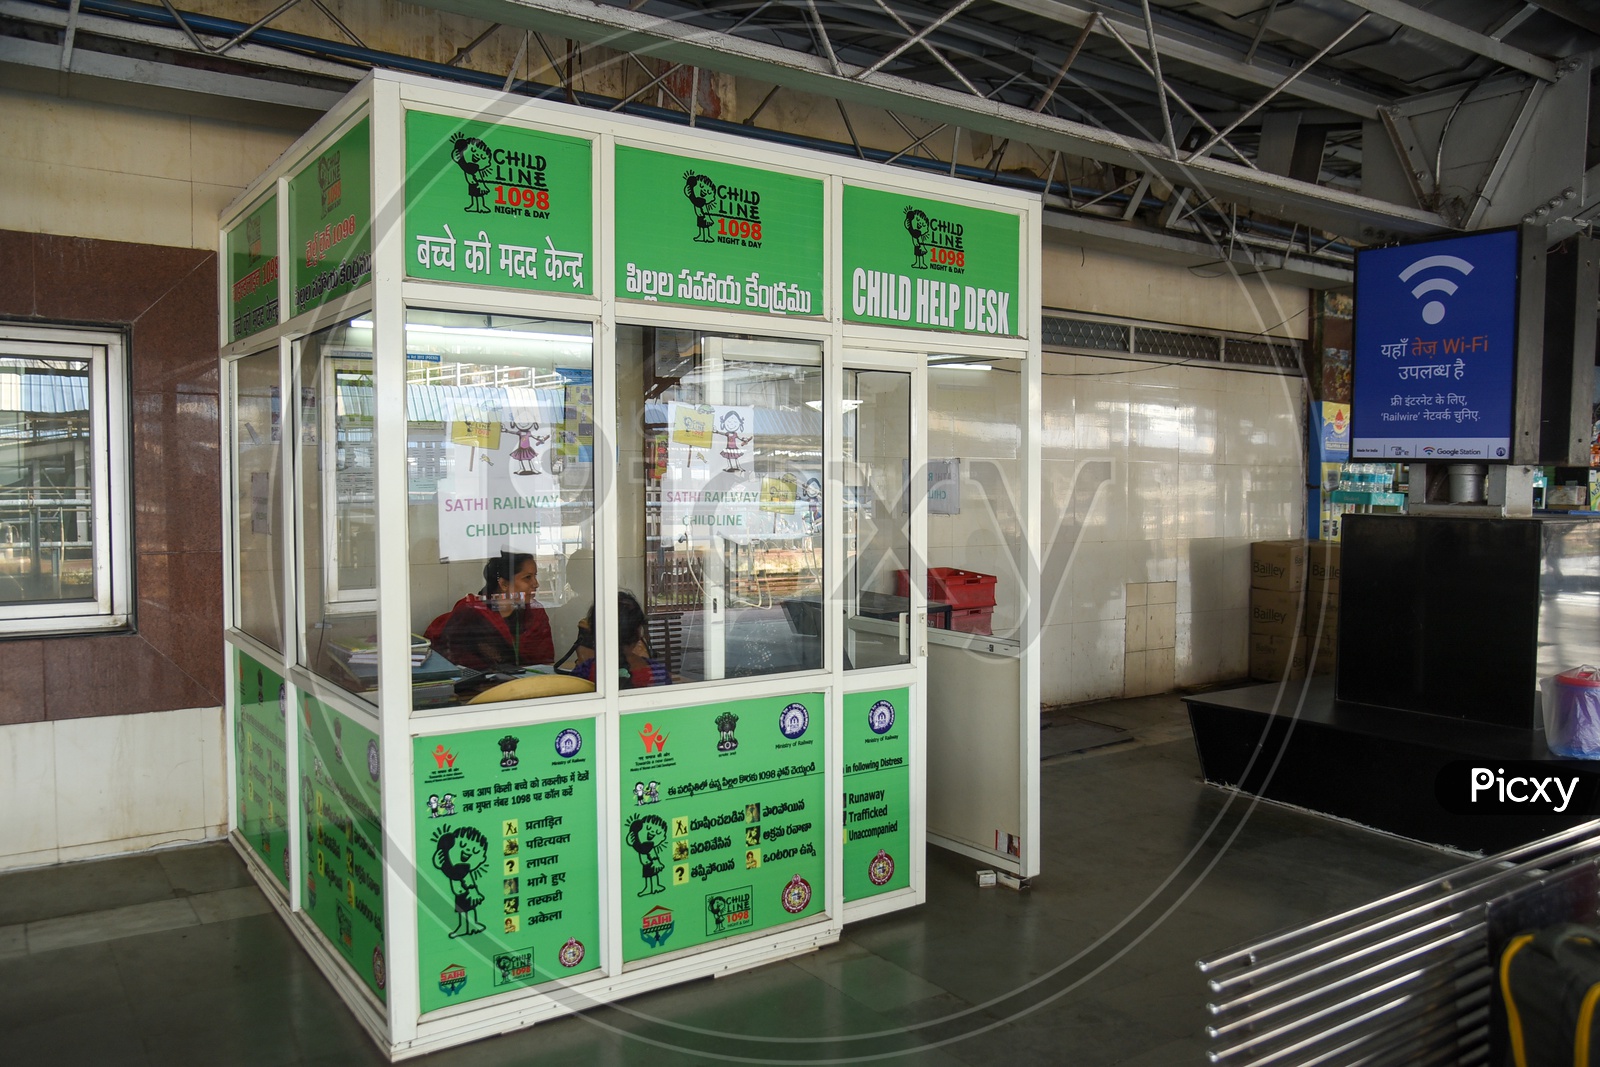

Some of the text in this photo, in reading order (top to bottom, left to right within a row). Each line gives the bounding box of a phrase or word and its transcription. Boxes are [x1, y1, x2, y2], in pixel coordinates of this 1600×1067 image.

[492, 148, 547, 171] CHILD
[496, 165, 547, 188] LINE
[494, 186, 550, 210] 1098
[717, 185, 760, 206] CHILD
[494, 205, 550, 220] NIGHT & DAY
[718, 200, 760, 220] LINE
[332, 214, 356, 246] 1098
[717, 218, 762, 240] 1098
[930, 218, 964, 236] CHILD
[717, 236, 740, 246] NIGHT
[748, 240, 762, 248] DAY
[931, 233, 963, 249] LINE
[416, 224, 584, 288] बच्चे की मदद केन्द्र
[930, 248, 964, 267] 1098
[930, 264, 947, 272] NIGHT
[678, 268, 742, 304] సహాయ
[745, 272, 811, 314] కేంద్రము
[852, 268, 1010, 334] CHILD HELP DESK
[1381, 335, 1489, 360] यहाँ तेज़ Wi-Fi
[1398, 358, 1466, 380] उपलब्ध है
[1390, 392, 1468, 406] फ्री इंटरनेट के लिए,
[1423, 409, 1451, 420] नेटवर्क
[1437, 448, 1481, 456] Google Station
[444, 495, 559, 512] SATHI RAILWAY
[666, 492, 759, 503] SATHI RAILWAY
[682, 514, 742, 526] CHILDLINE
[466, 521, 541, 538] CHILDLINE
[1252, 562, 1286, 578] Bailley
[1312, 564, 1340, 578] Baille
[1253, 607, 1288, 624] Bailley
[775, 742, 791, 750] Ministry
[846, 756, 903, 773] in following Distress
[759, 770, 776, 780] 1098
[462, 789, 475, 798] जब
[477, 786, 492, 796] आप
[494, 781, 512, 794] किसी
[530, 777, 539, 788] को
[541, 774, 568, 787] तकलीफ
[462, 803, 474, 812] तब
[494, 796, 509, 807] नंबर
[512, 794, 531, 805] 1098
[533, 792, 542, 801] पर
[562, 785, 573, 796] करें
[848, 788, 885, 805] Runaway
[848, 804, 888, 823] Trafficked
[525, 815, 562, 831] प्रताड़ित
[848, 820, 898, 841] Unaccompanied
[526, 854, 559, 869] लापता
[527, 872, 566, 887] भागे हुए
[527, 890, 562, 907] तस्करी
[726, 893, 750, 905] CHILD
[727, 901, 750, 912] LINE
[528, 910, 562, 926] अकेला
[642, 912, 672, 929] SATHI
[727, 910, 749, 923] 1098
[440, 969, 465, 982] SATHI
[512, 966, 531, 976] 1098
